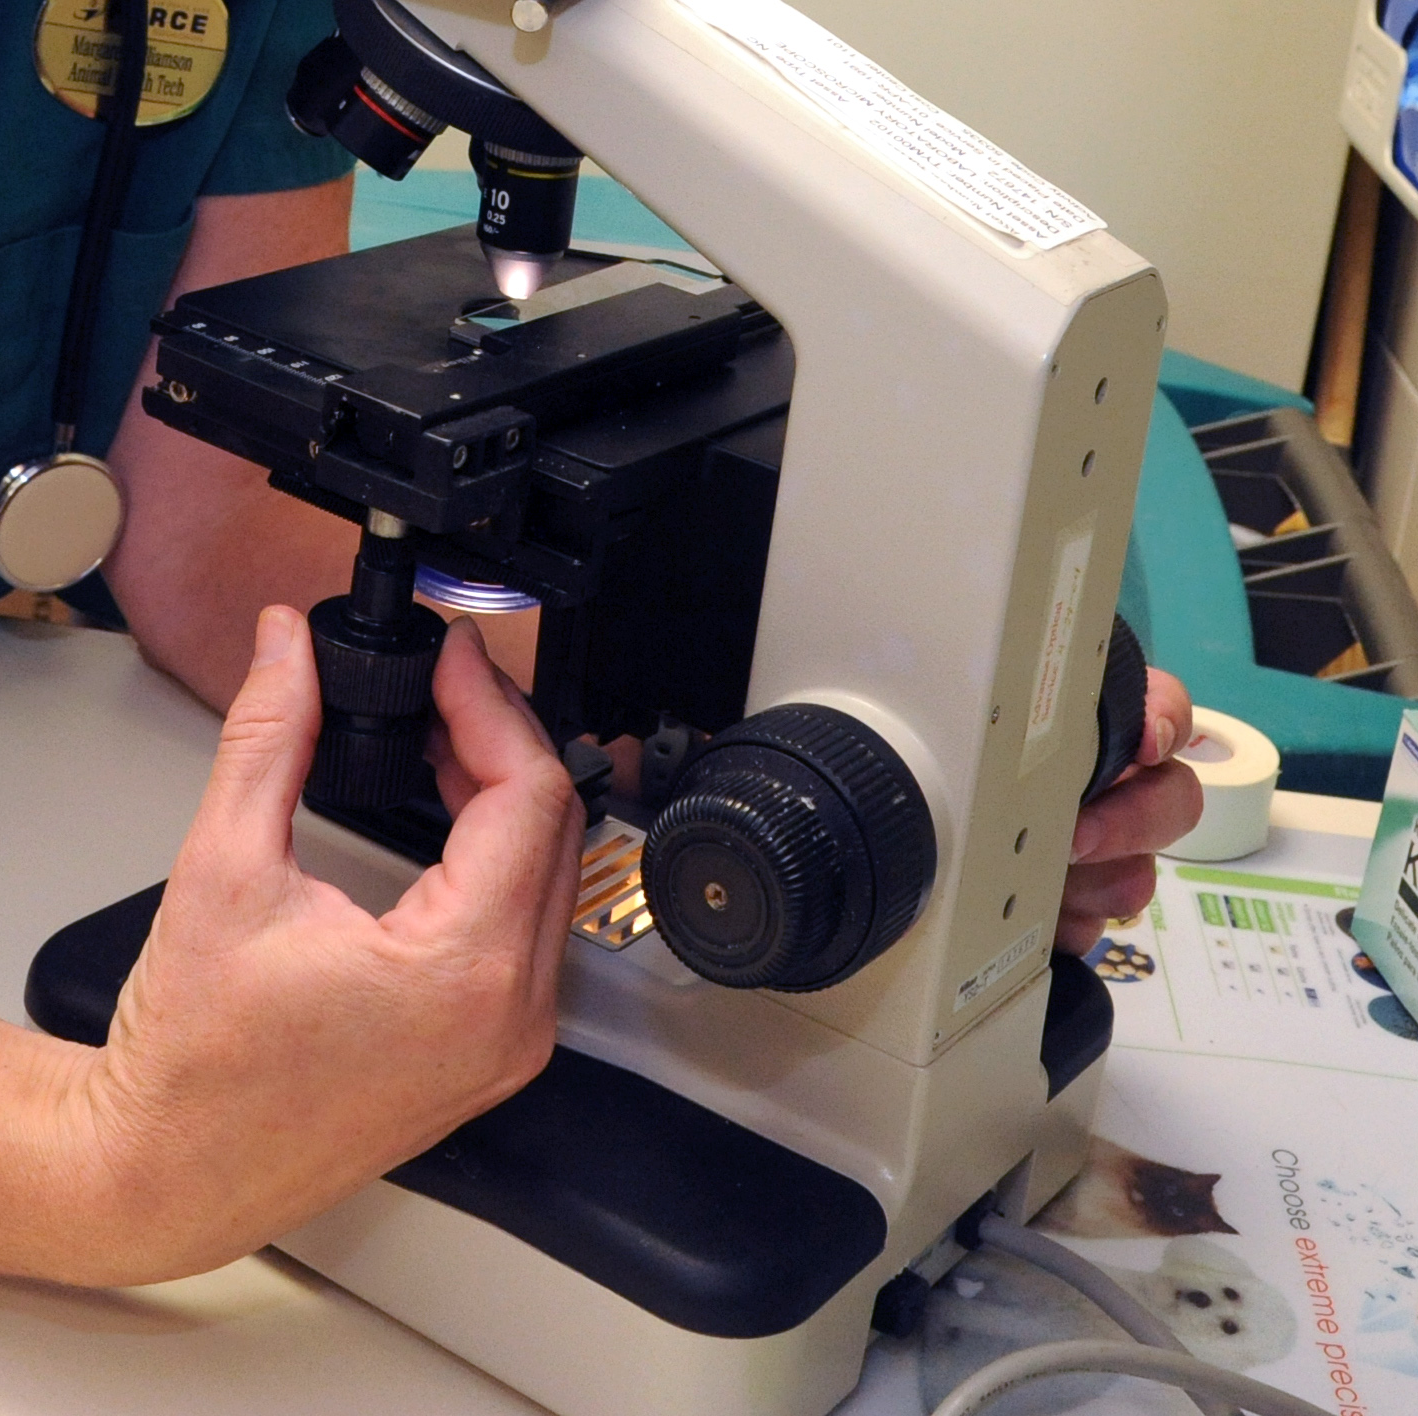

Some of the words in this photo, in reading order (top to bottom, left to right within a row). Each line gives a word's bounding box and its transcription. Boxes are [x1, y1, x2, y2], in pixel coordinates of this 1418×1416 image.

[148, 7, 209, 35] RCE
[770, 40, 877, 107] MICROSCOPE
[873, 108, 980, 177] LABORATORY
[486, 210, 506, 225] 0.25
[491, 188, 510, 210] 10
[1271, 1148, 1311, 1231] Choose
[1294, 1237, 1339, 1335] extreme
